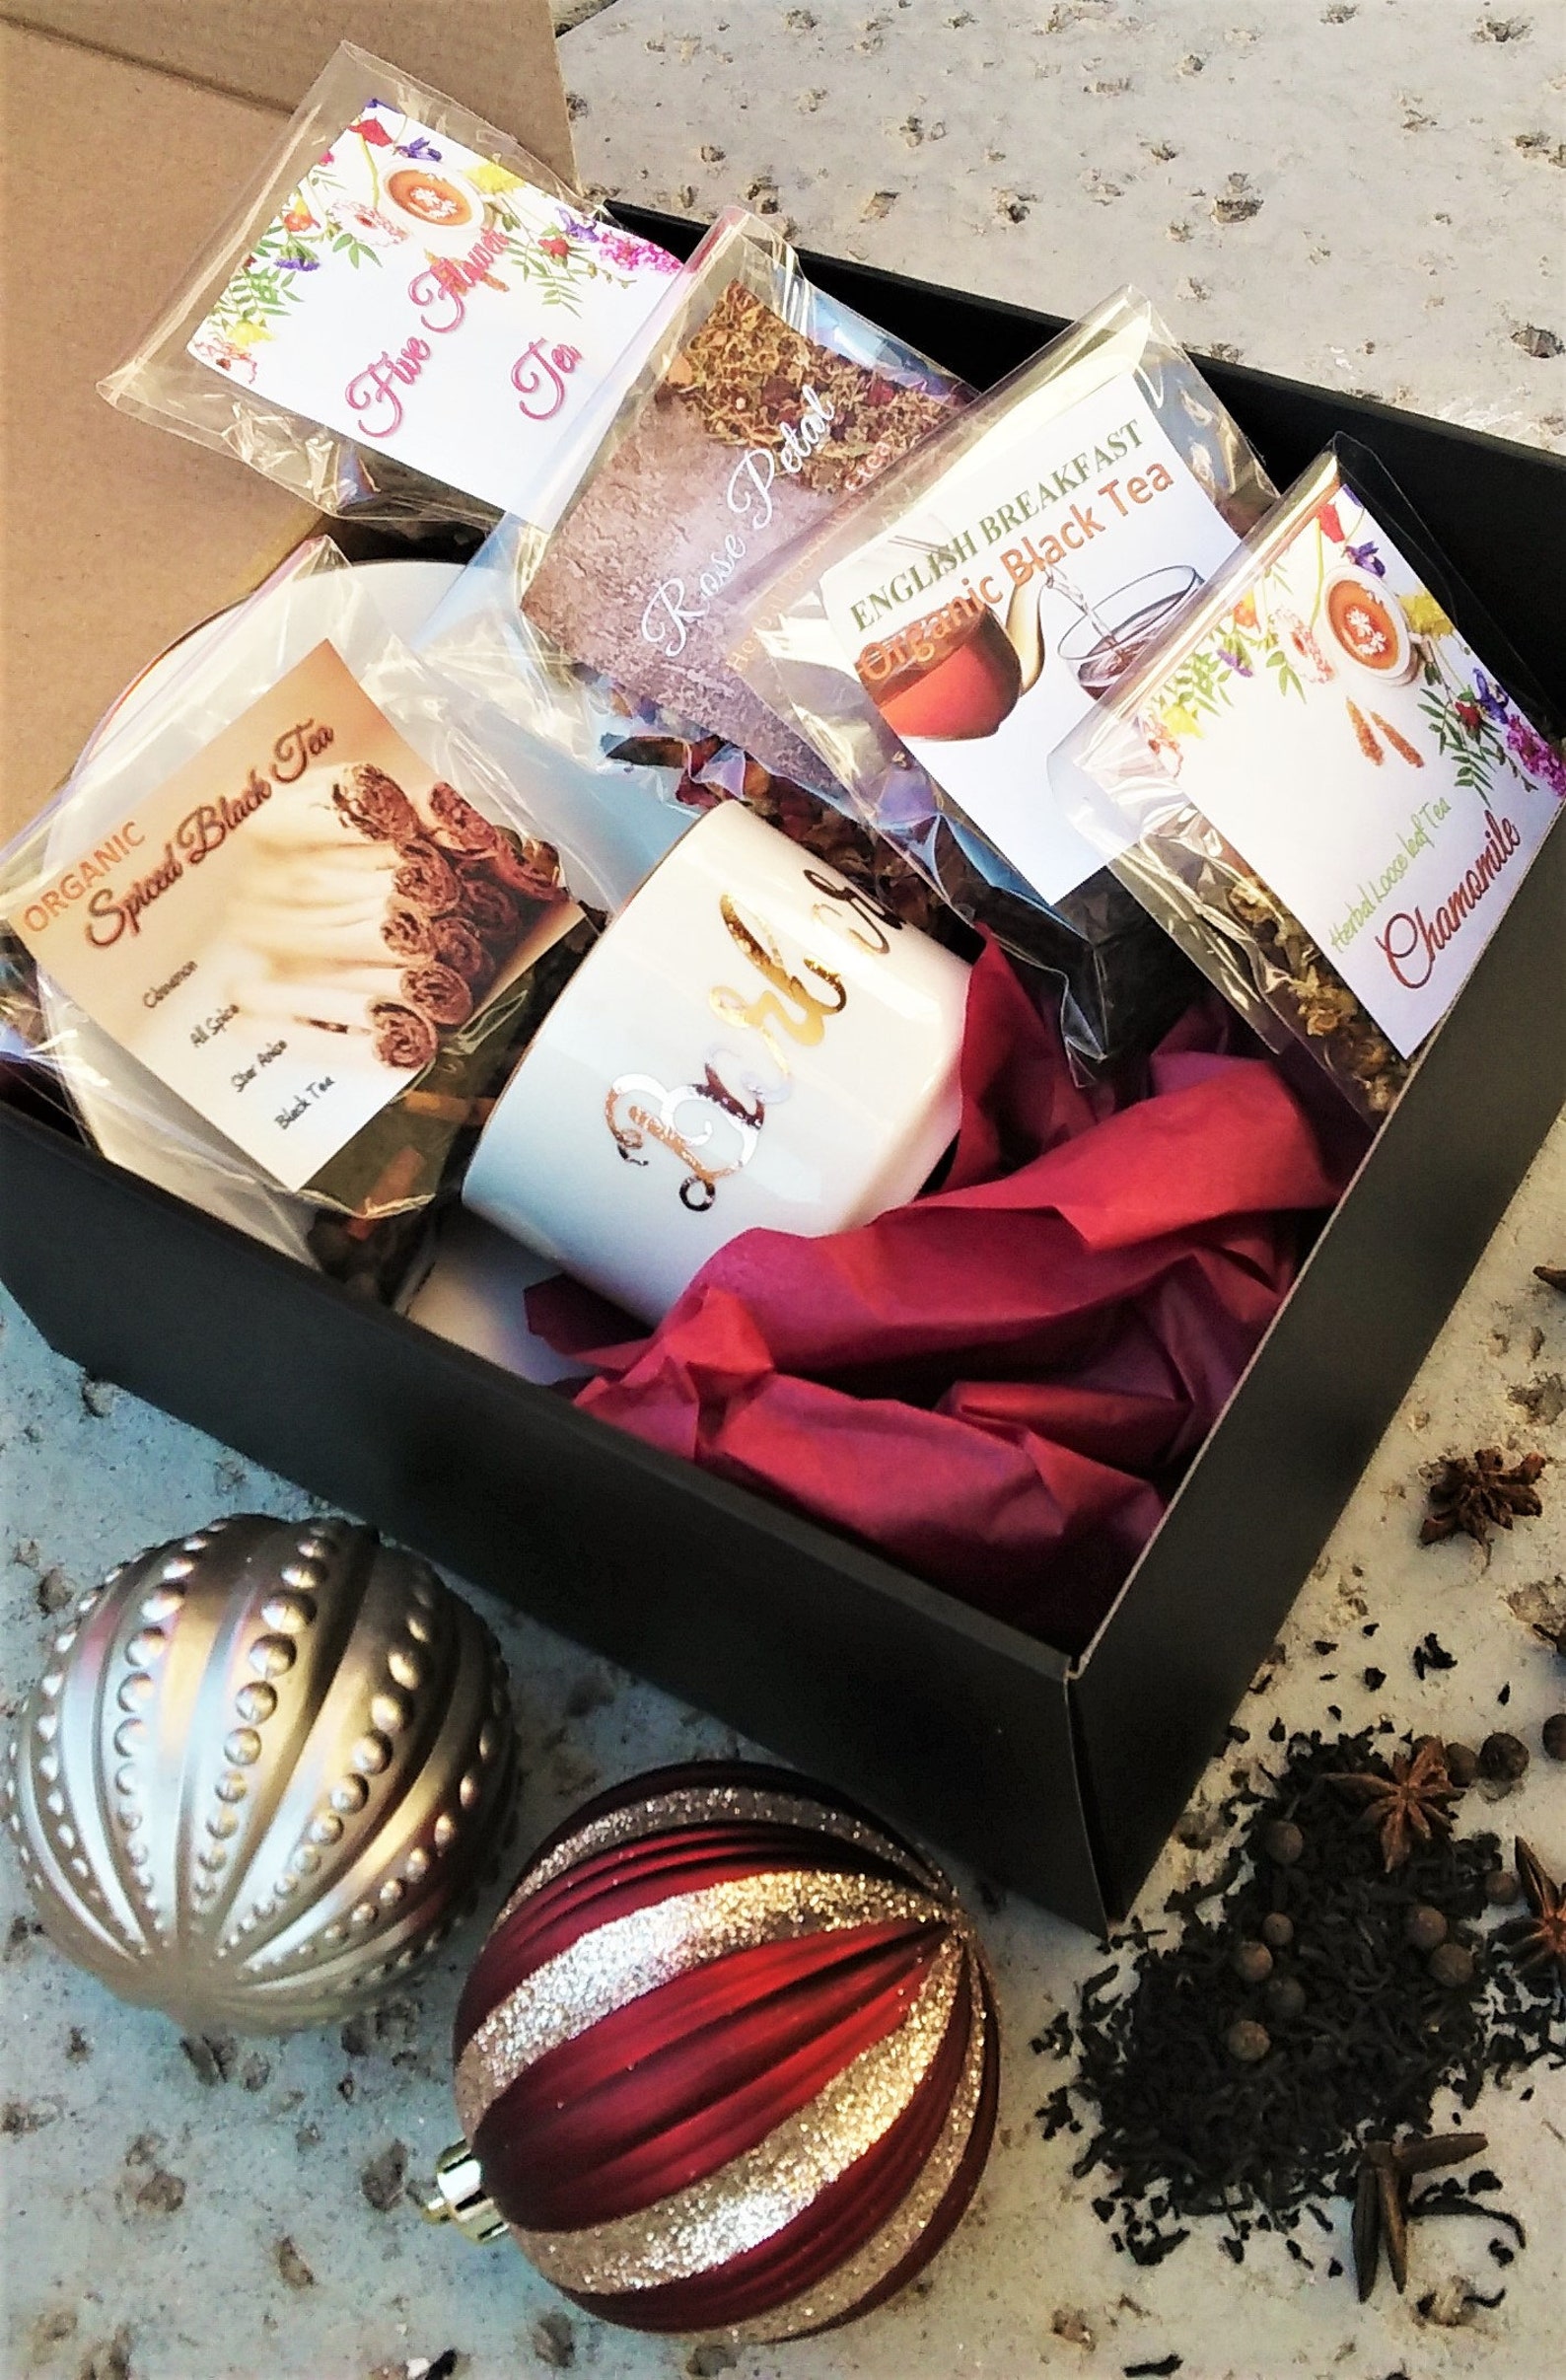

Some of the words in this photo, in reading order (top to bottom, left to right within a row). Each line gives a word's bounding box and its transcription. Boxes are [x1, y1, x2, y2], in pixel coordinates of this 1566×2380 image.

[345, 336, 431, 438] Five
[511, 337, 582, 420] Tea
[641, 534, 747, 657] Rose
[727, 384, 835, 530] Petal
[849, 531, 978, 632] ENGLISH
[977, 419, 1144, 545] BREAKFAST
[858, 576, 1003, 681] Organic
[1000, 504, 1105, 586] Black
[1098, 462, 1174, 517] Tea
[24, 821, 145, 932] ORGANIC
[85, 843, 182, 947] Spiced
[177, 769, 272, 863] Black
[271, 718, 334, 784] Tea
[1329, 884, 1376, 954] Herbal
[1419, 797, 1452, 828] Tea
[1375, 809, 1521, 989] Chamomile
[274, 1095, 312, 1129] Black
[306, 1076, 335, 1099] Tea
